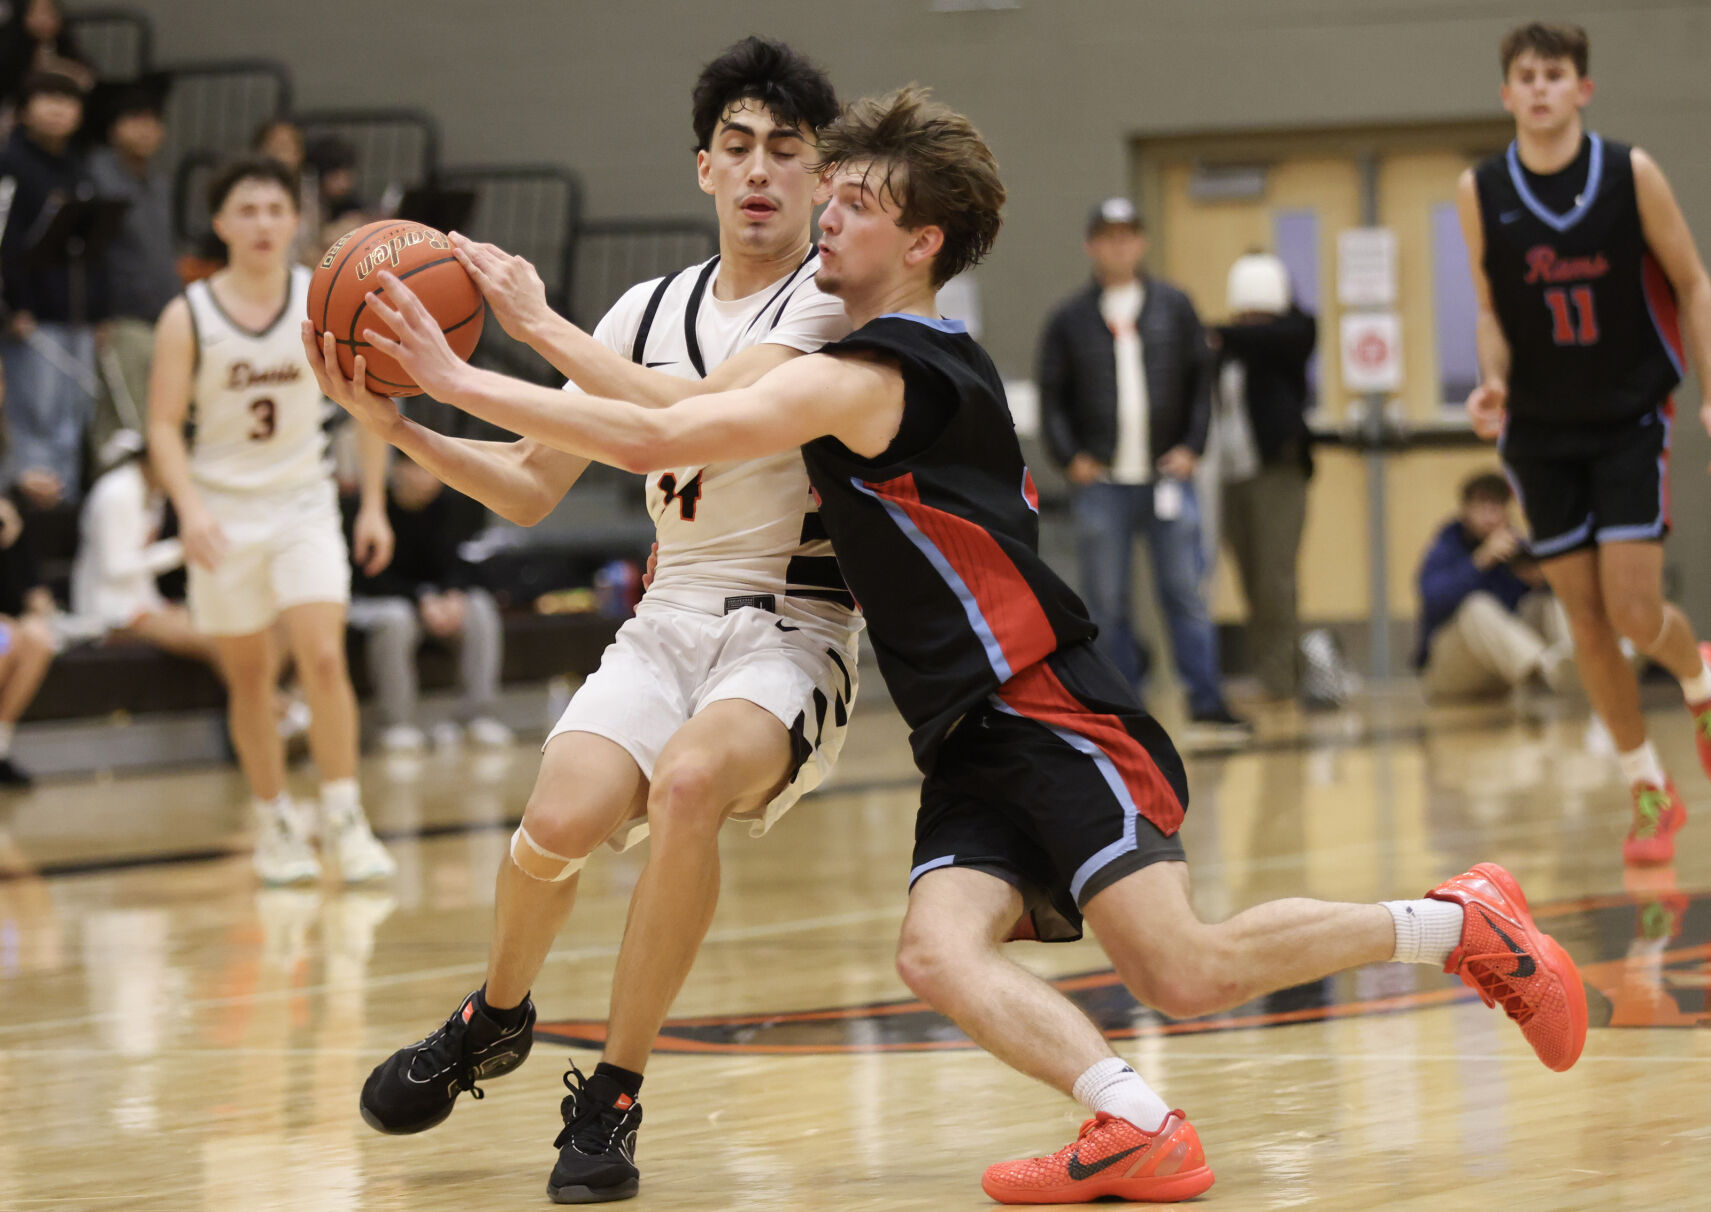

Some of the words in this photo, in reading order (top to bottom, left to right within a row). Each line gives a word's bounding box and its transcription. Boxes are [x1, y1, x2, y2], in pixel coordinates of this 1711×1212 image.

[355, 230, 450, 281] Baden
[1544, 287, 1599, 344] 11
[248, 397, 275, 441] 3
